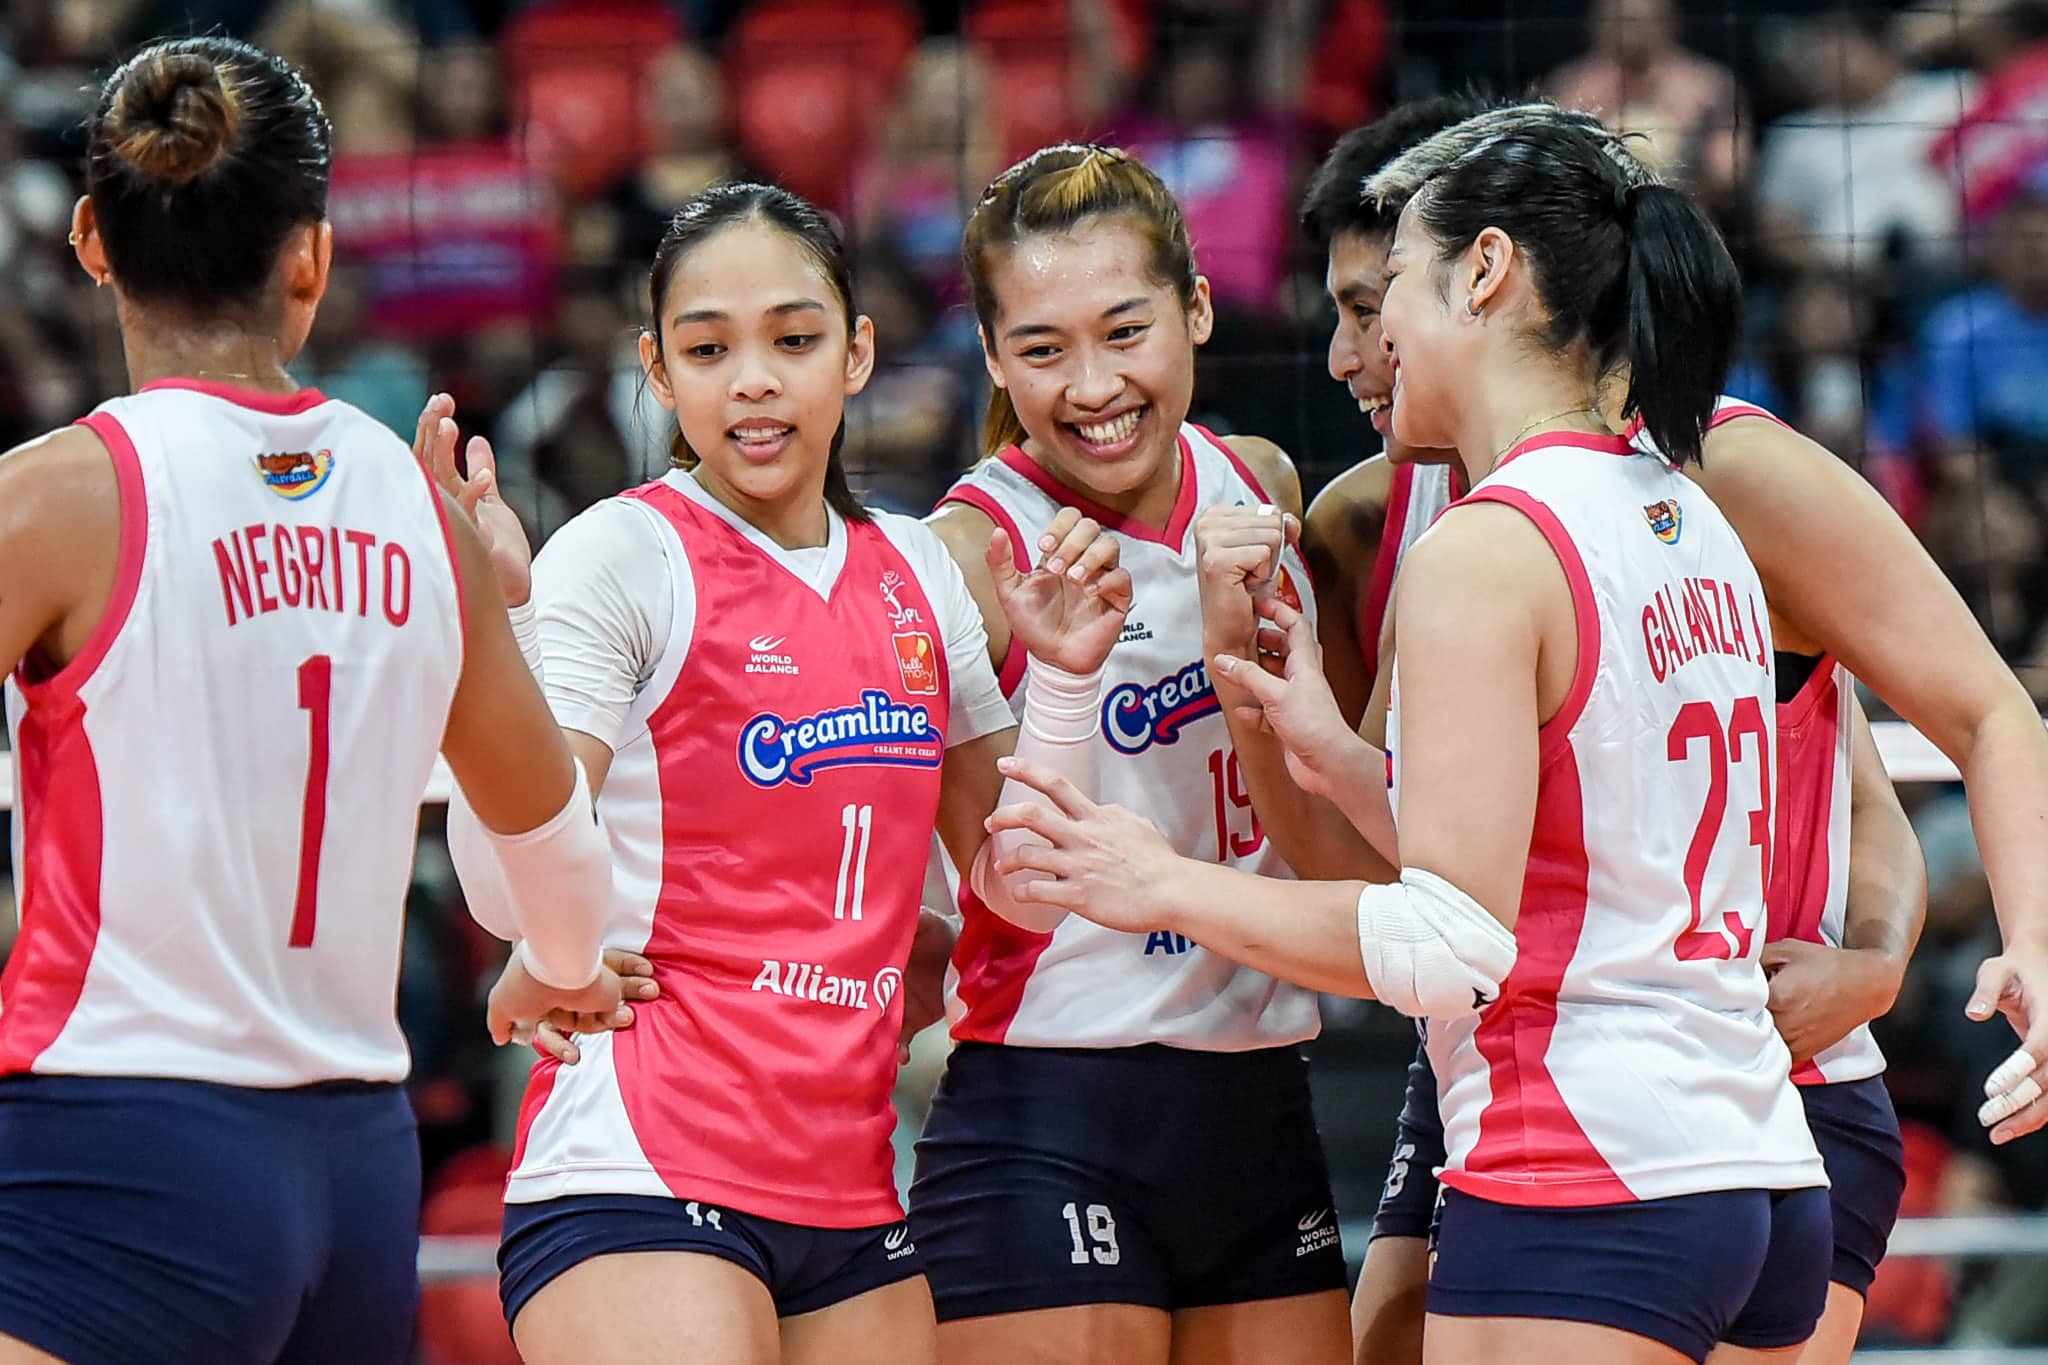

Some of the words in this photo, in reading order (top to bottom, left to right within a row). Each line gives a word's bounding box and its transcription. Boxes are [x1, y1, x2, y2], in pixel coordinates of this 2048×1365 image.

[211, 523, 411, 627] NEGRITO
[750, 653, 793, 665] WORLD
[1117, 630, 1153, 643] LANCE
[1122, 622, 1145, 633] RLD
[1641, 577, 1751, 684] GALANZA
[744, 664, 800, 675] BALANCE
[744, 696, 928, 782] Creamline
[873, 744, 904, 755] CREAMY
[288, 654, 332, 949] 1
[1207, 749, 1265, 862] 19
[1667, 696, 1772, 961] 23
[834, 804, 872, 920] 11
[752, 960, 868, 1009] Allianz
[1062, 1203, 1121, 1265] 19
